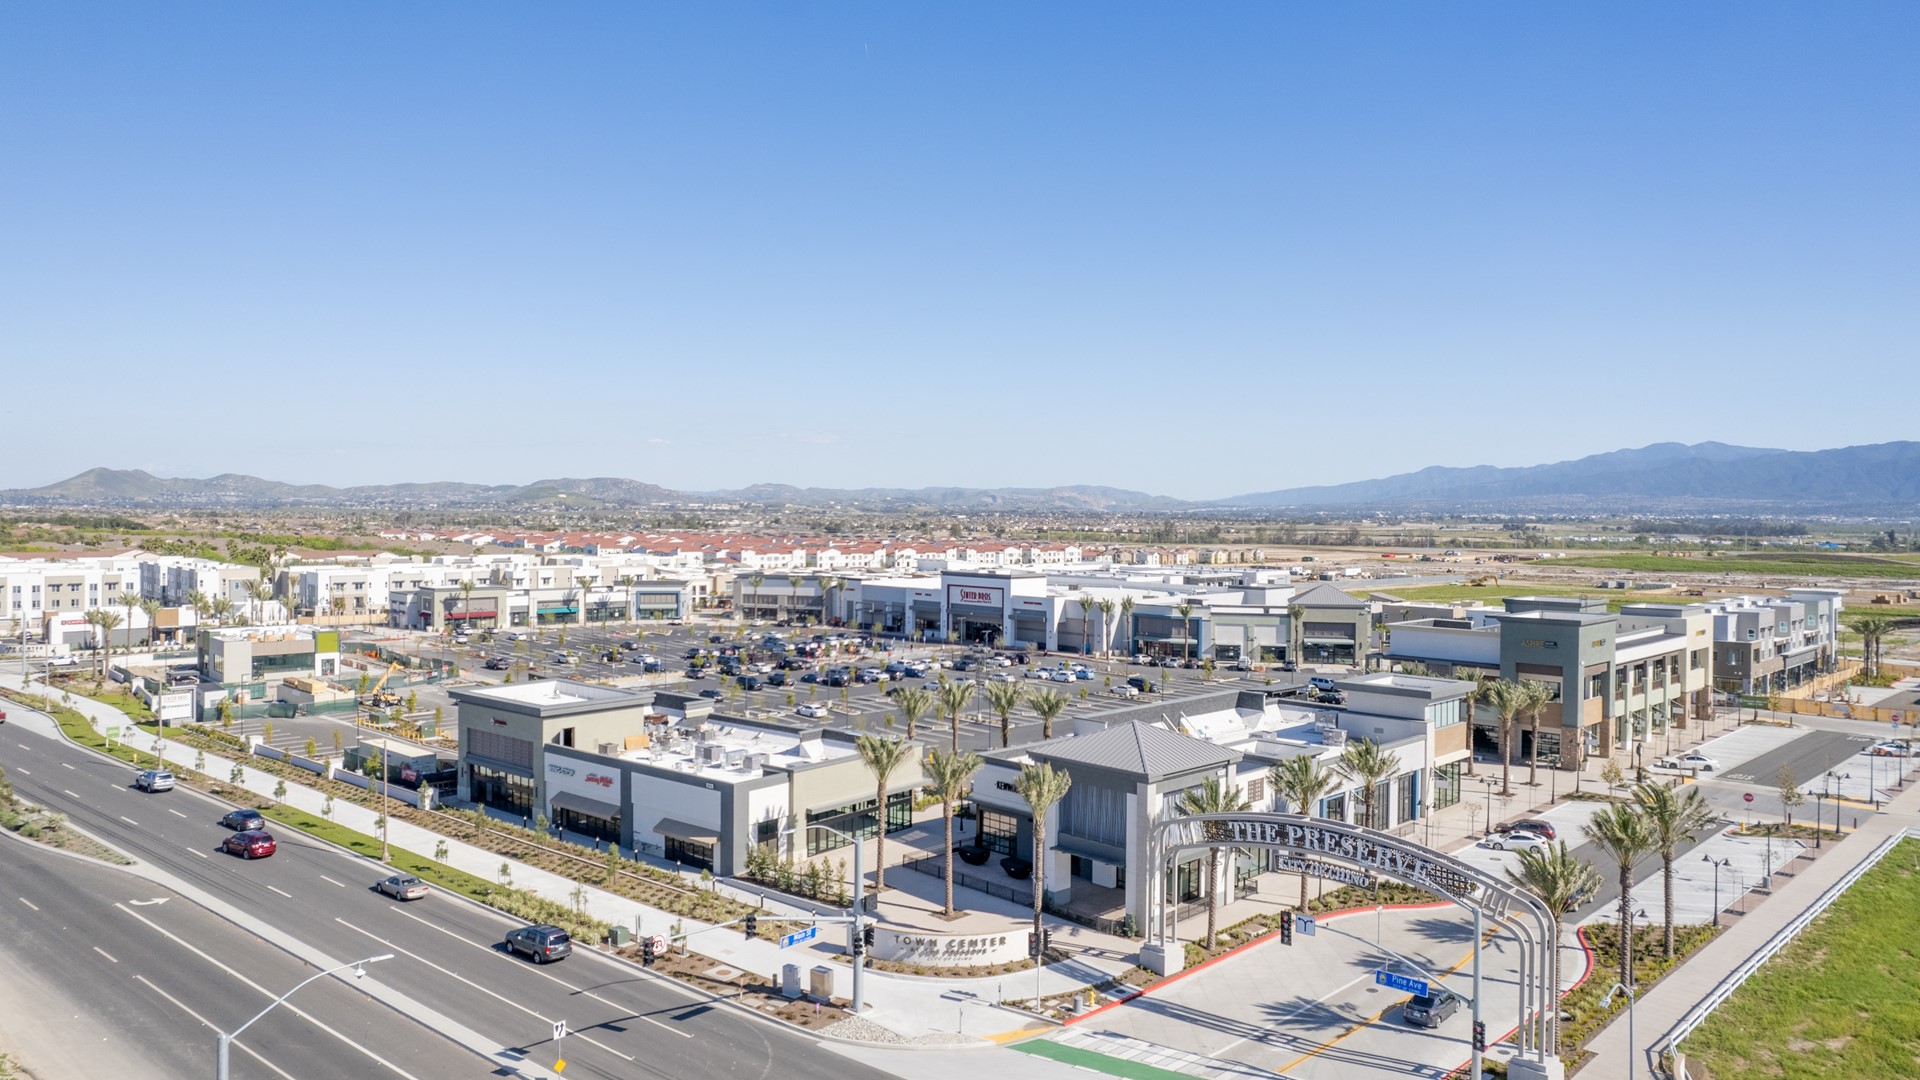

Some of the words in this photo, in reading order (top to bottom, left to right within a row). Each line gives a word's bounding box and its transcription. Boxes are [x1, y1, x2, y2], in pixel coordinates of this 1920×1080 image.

[1228, 821, 1281, 844] THE
[1286, 824, 1434, 886] PRESERVE
[1279, 857, 1308, 873] CITY
[1311, 861, 1326, 877] OF
[1328, 867, 1370, 888] CHINO
[894, 935, 938, 947] TOWN
[949, 936, 1007, 949] CENTER
[1392, 974, 1407, 985] Pine
[1408, 979, 1422, 990] Ave
